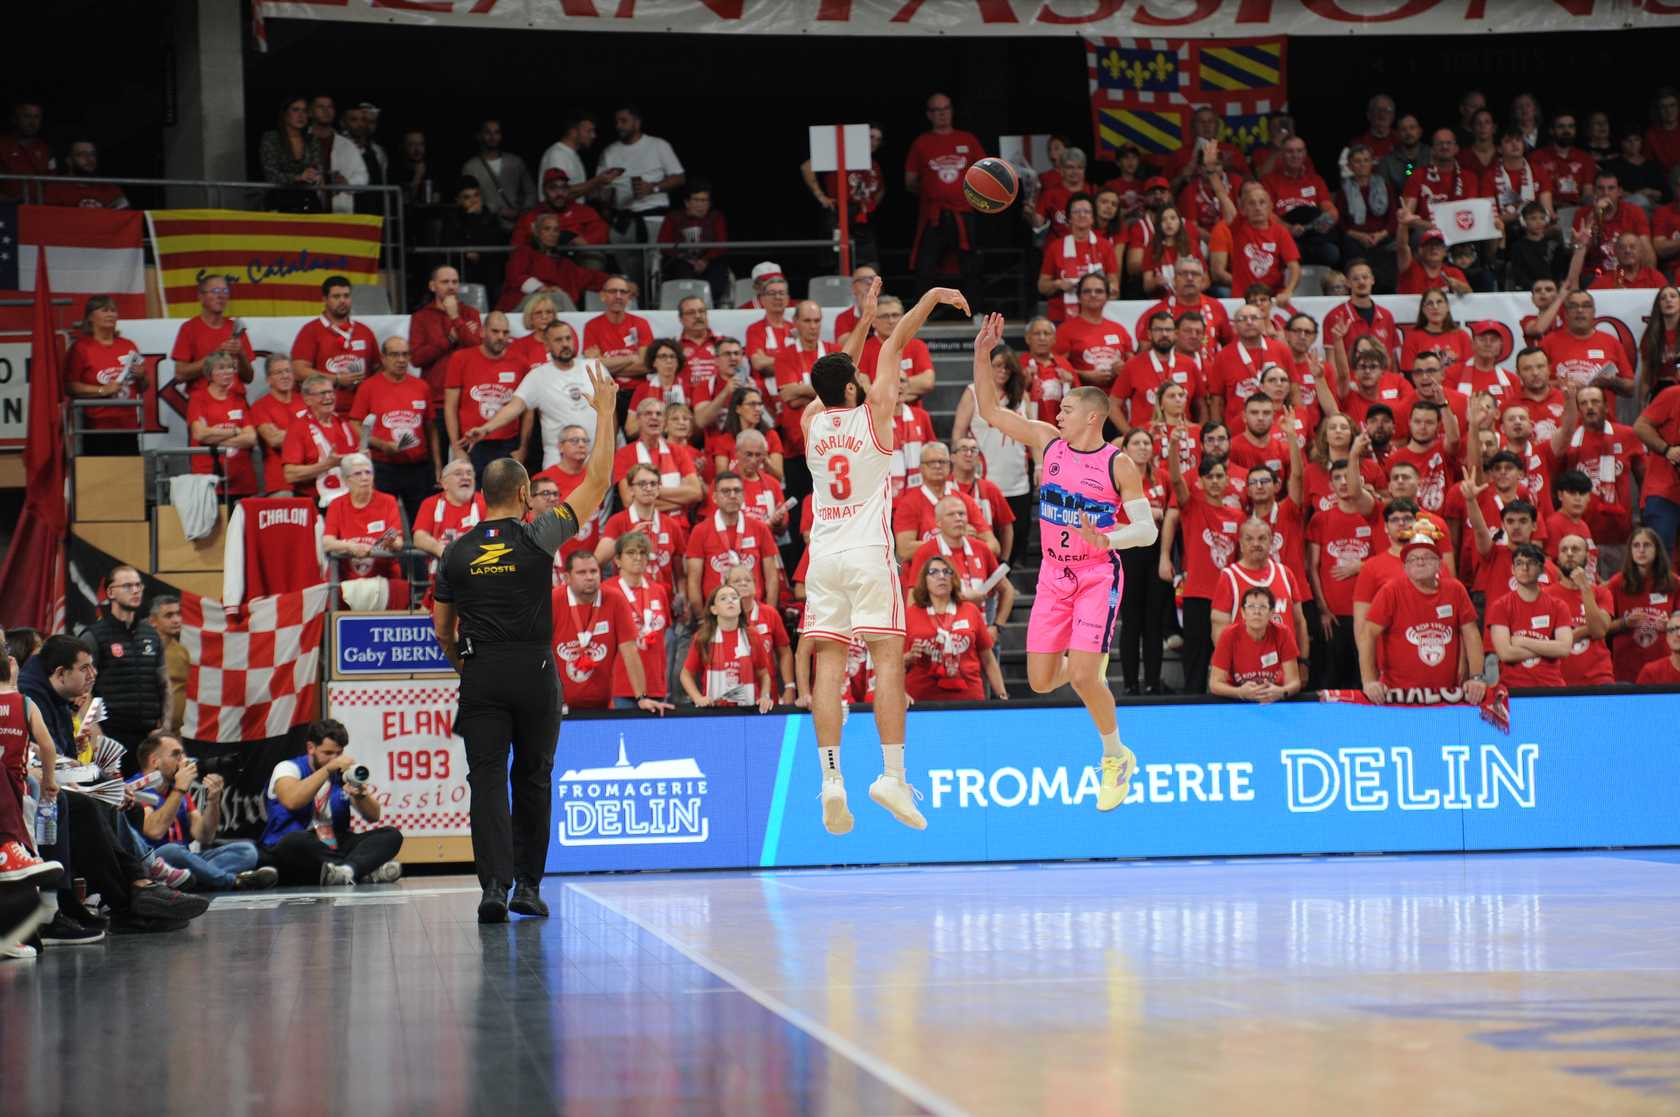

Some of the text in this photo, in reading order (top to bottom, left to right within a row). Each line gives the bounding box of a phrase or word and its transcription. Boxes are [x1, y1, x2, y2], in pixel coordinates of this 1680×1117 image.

[815, 434, 863, 456] DARLING
[828, 454, 851, 500] 3
[258, 508, 308, 530] CHALON
[1060, 530, 1070, 548] 2
[343, 647, 386, 667] Gaby
[382, 709, 453, 741] ELAN
[387, 749, 450, 781] 1993
[558, 781, 708, 799] FROMAGERIE
[1280, 743, 1539, 813] DELIN
[368, 785, 466, 809] assio
[564, 797, 702, 836] DELIN
